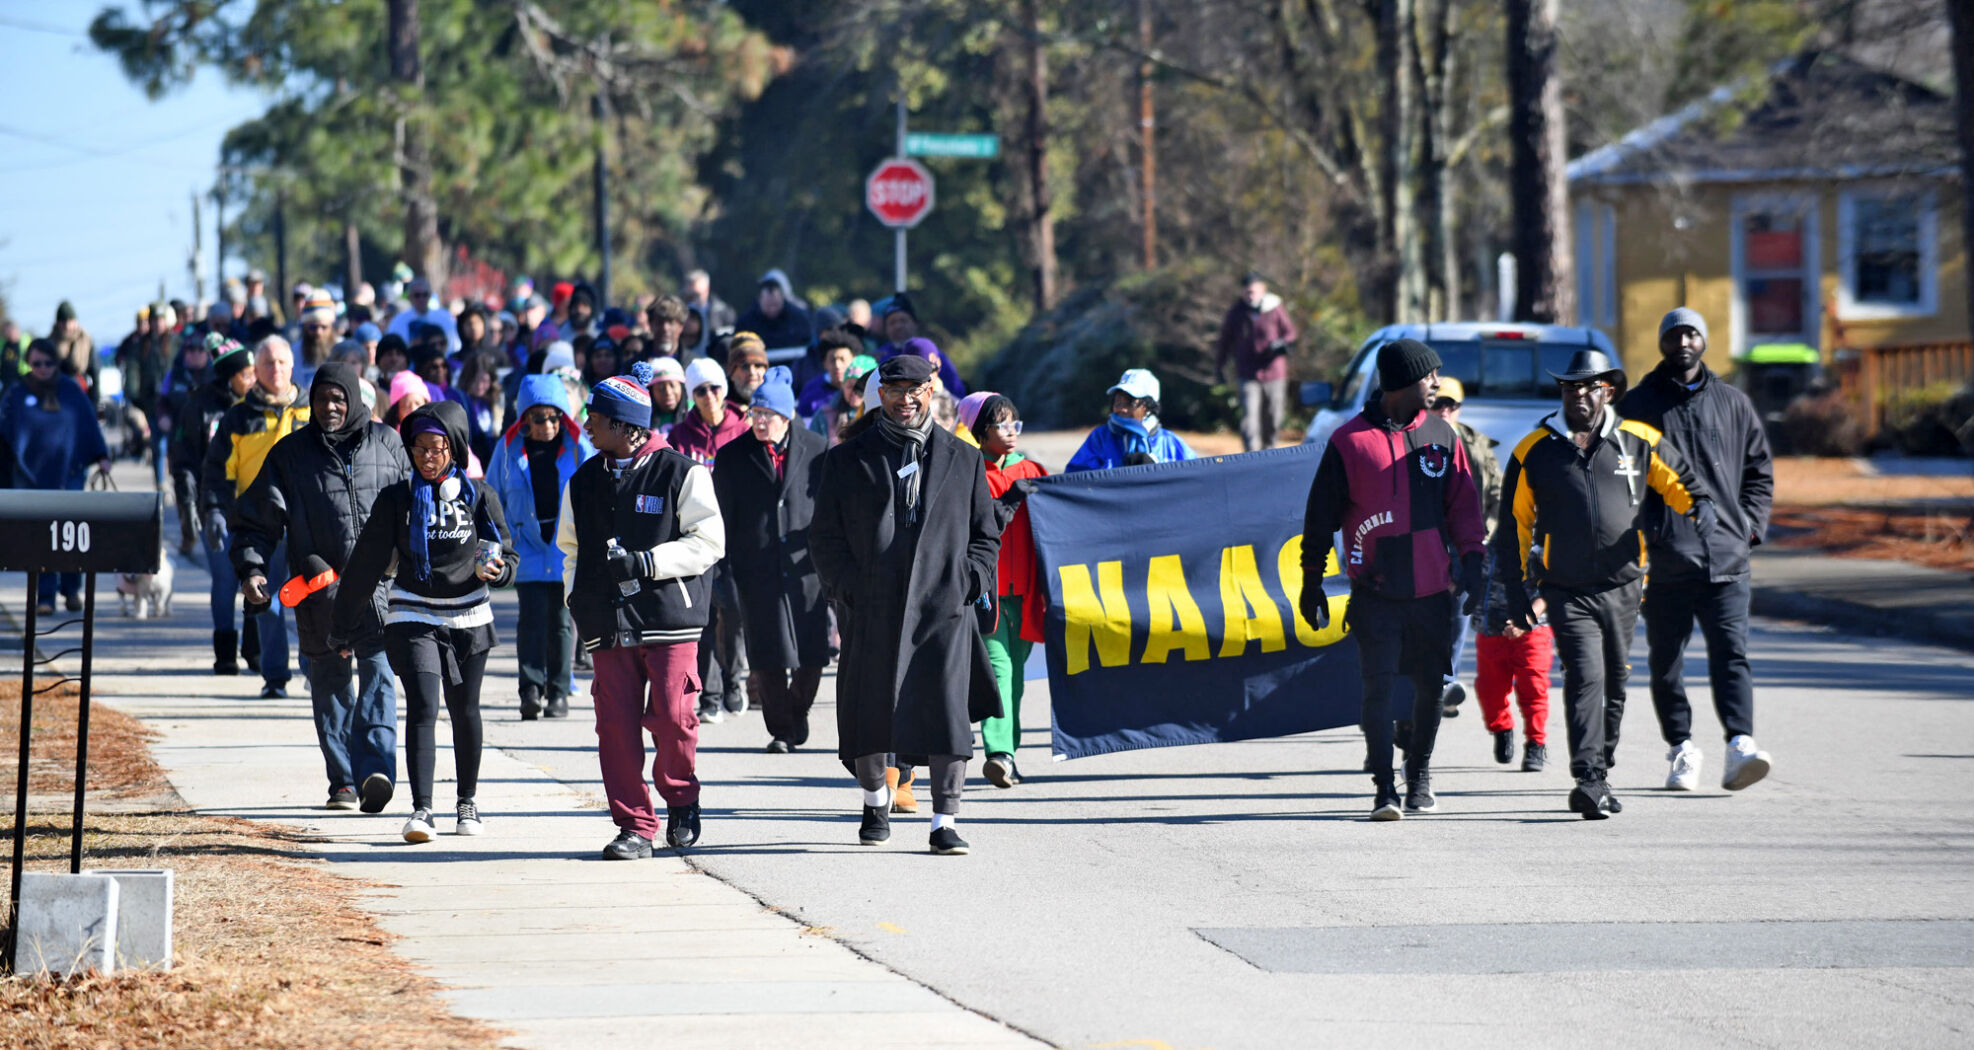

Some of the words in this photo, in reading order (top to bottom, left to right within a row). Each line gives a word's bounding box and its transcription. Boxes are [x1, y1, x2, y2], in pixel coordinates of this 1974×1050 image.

[871, 179, 924, 206] STOP
[50, 520, 90, 553] 190
[438, 525, 472, 544] today
[1350, 510, 1393, 565] CALIFORNIA
